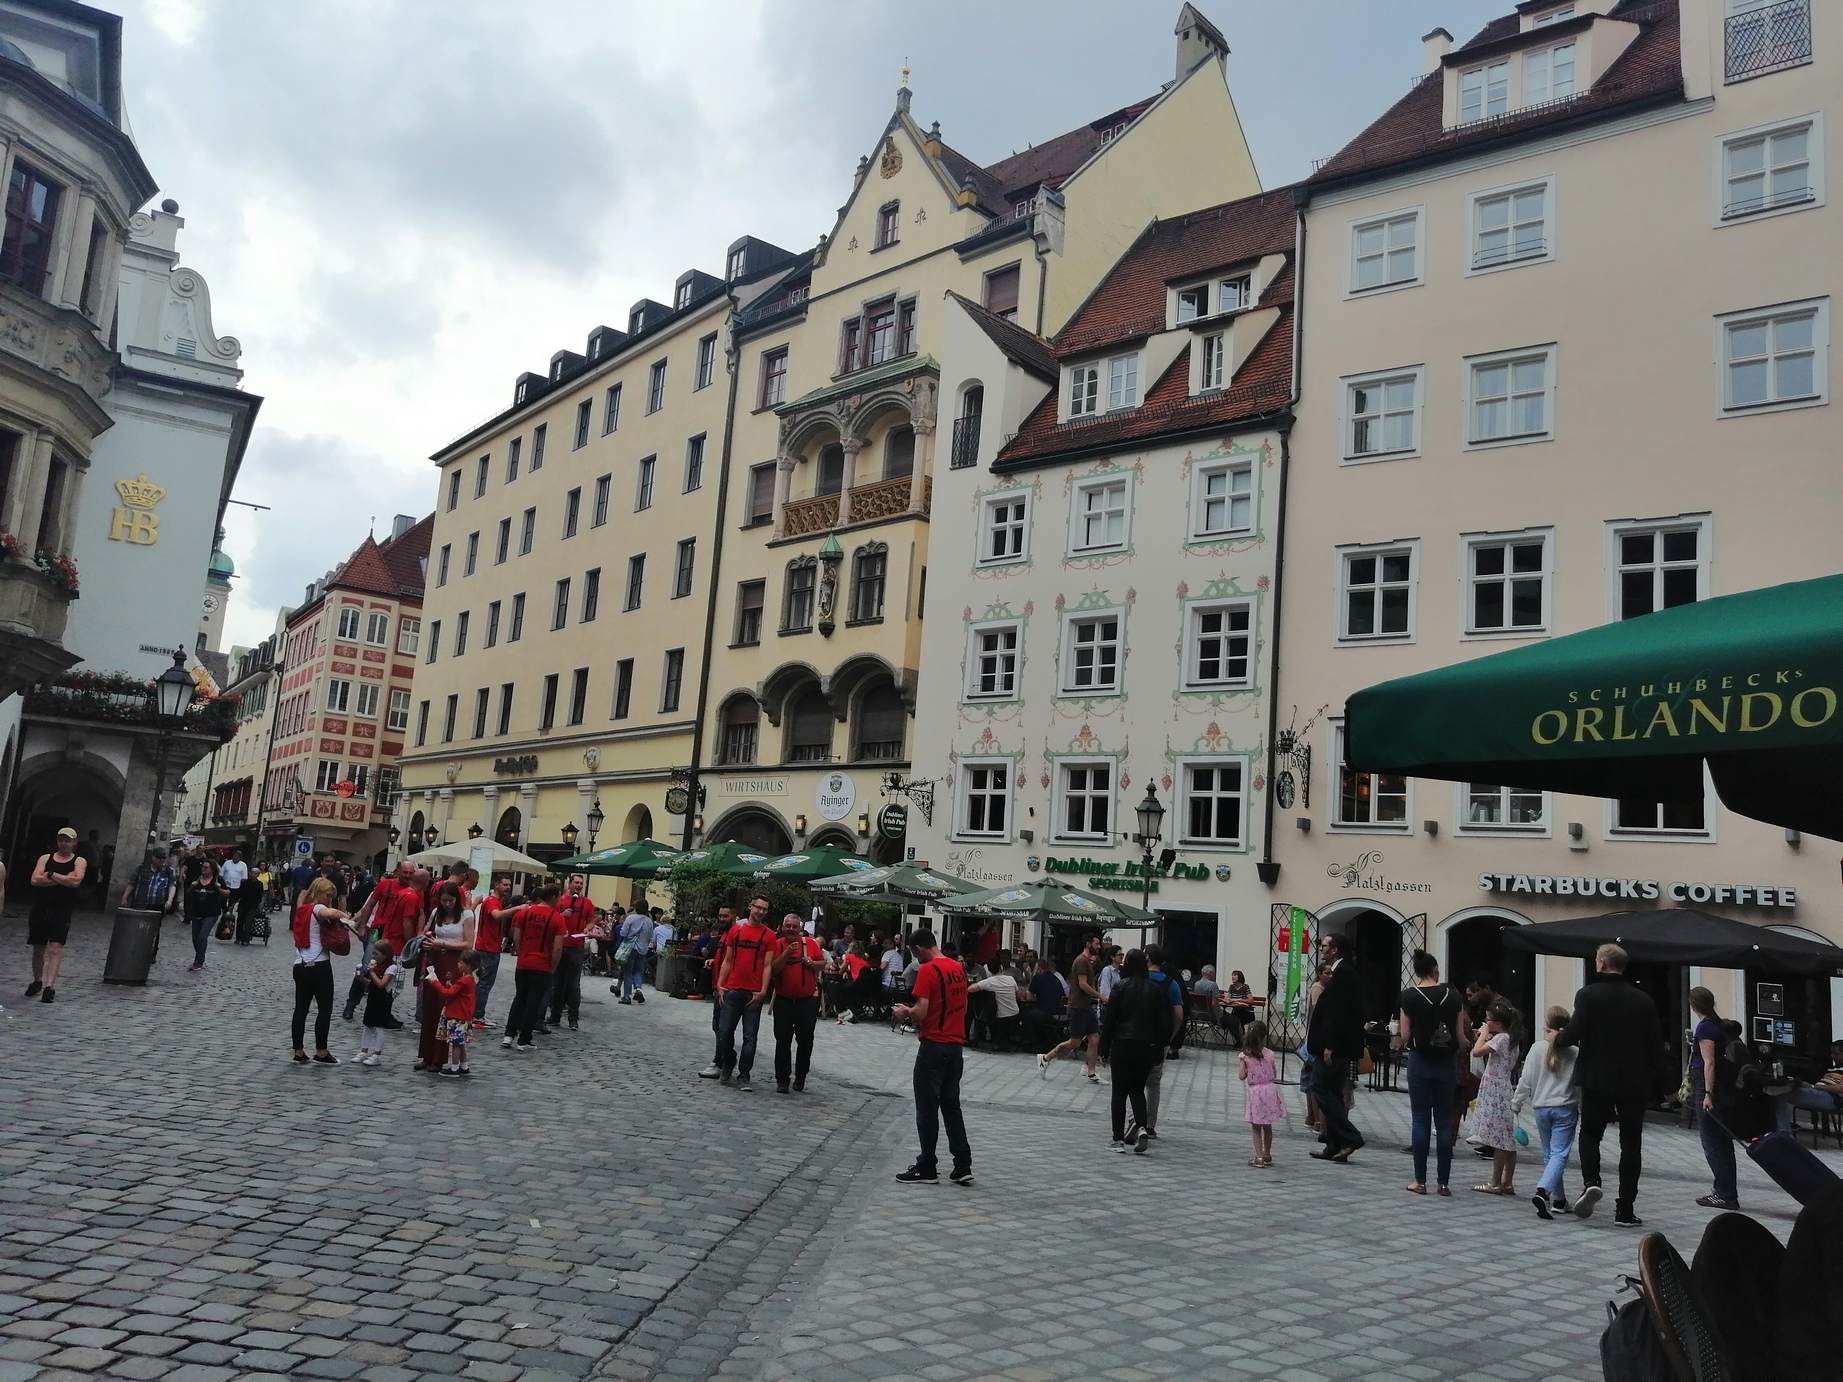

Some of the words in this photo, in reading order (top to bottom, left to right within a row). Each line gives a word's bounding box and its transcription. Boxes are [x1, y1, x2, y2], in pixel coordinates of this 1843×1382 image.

[108, 507, 159, 545] HB
[140, 645, 158, 653] ANNO
[1531, 686, 1837, 745] ORLANDO
[725, 780, 783, 792] WIRTSHAUS
[820, 794, 849, 807] Ayinger
[883, 817, 895, 825] Irish
[753, 870, 770, 879] Ayinger
[1044, 857, 1120, 876] Dubliner
[1173, 862, 1211, 880] Pub
[1331, 857, 1432, 893] Platzlgassen
[1477, 872, 1660, 900] STARBUCKS
[1666, 881, 1797, 907] COFFEE
[1096, 914, 1116, 923] Ayinger
